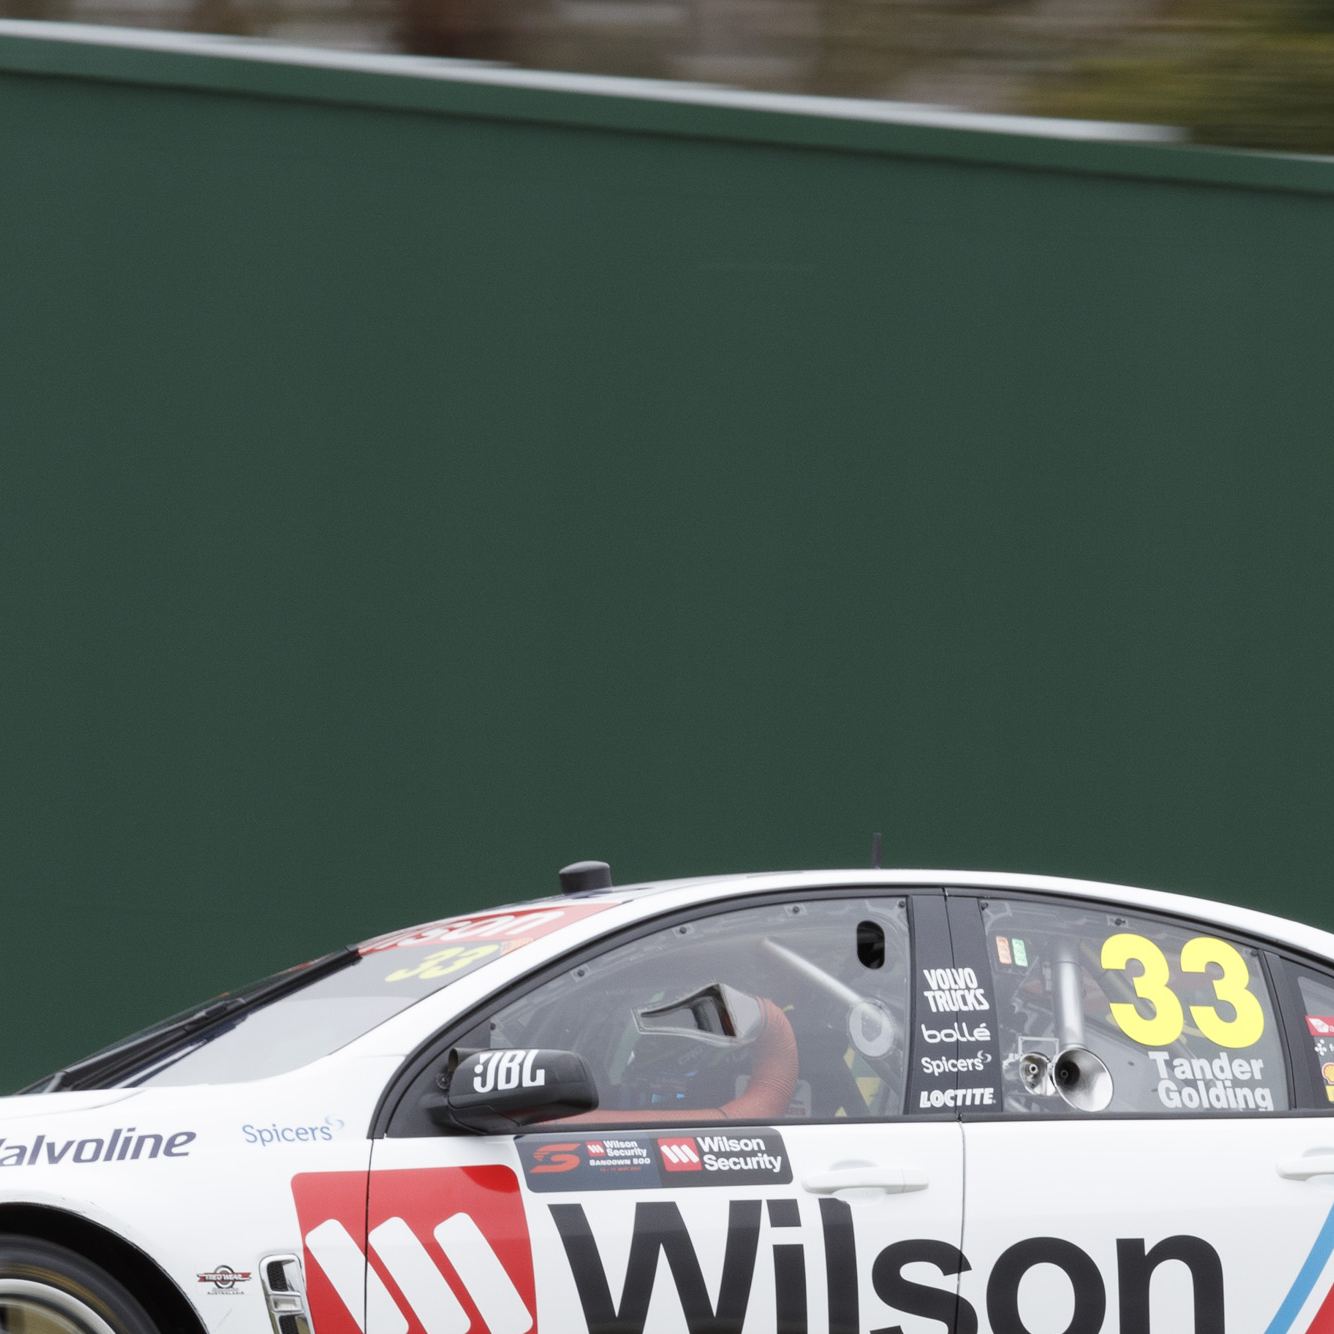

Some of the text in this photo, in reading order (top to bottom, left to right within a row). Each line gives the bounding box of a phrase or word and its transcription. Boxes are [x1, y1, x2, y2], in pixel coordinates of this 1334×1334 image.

[384, 944, 500, 982] 33
[923, 967, 978, 990] VOLVO
[924, 989, 990, 1013] TRUCKS
[1101, 933, 1265, 1049] 33
[921, 1022, 991, 1043] bollé
[473, 1050, 545, 1093] JBL
[921, 1056, 985, 1076] Spicers
[1148, 1051, 1264, 1080] Tander
[920, 1087, 995, 1108] LOCTITE
[1158, 1079, 1274, 1111] Golding
[242, 1124, 332, 1147] Spicers
[603, 1140, 638, 1149] Wilson
[697, 1136, 766, 1152] Wilson
[606, 1147, 647, 1158] Security
[703, 1152, 782, 1173] Security
